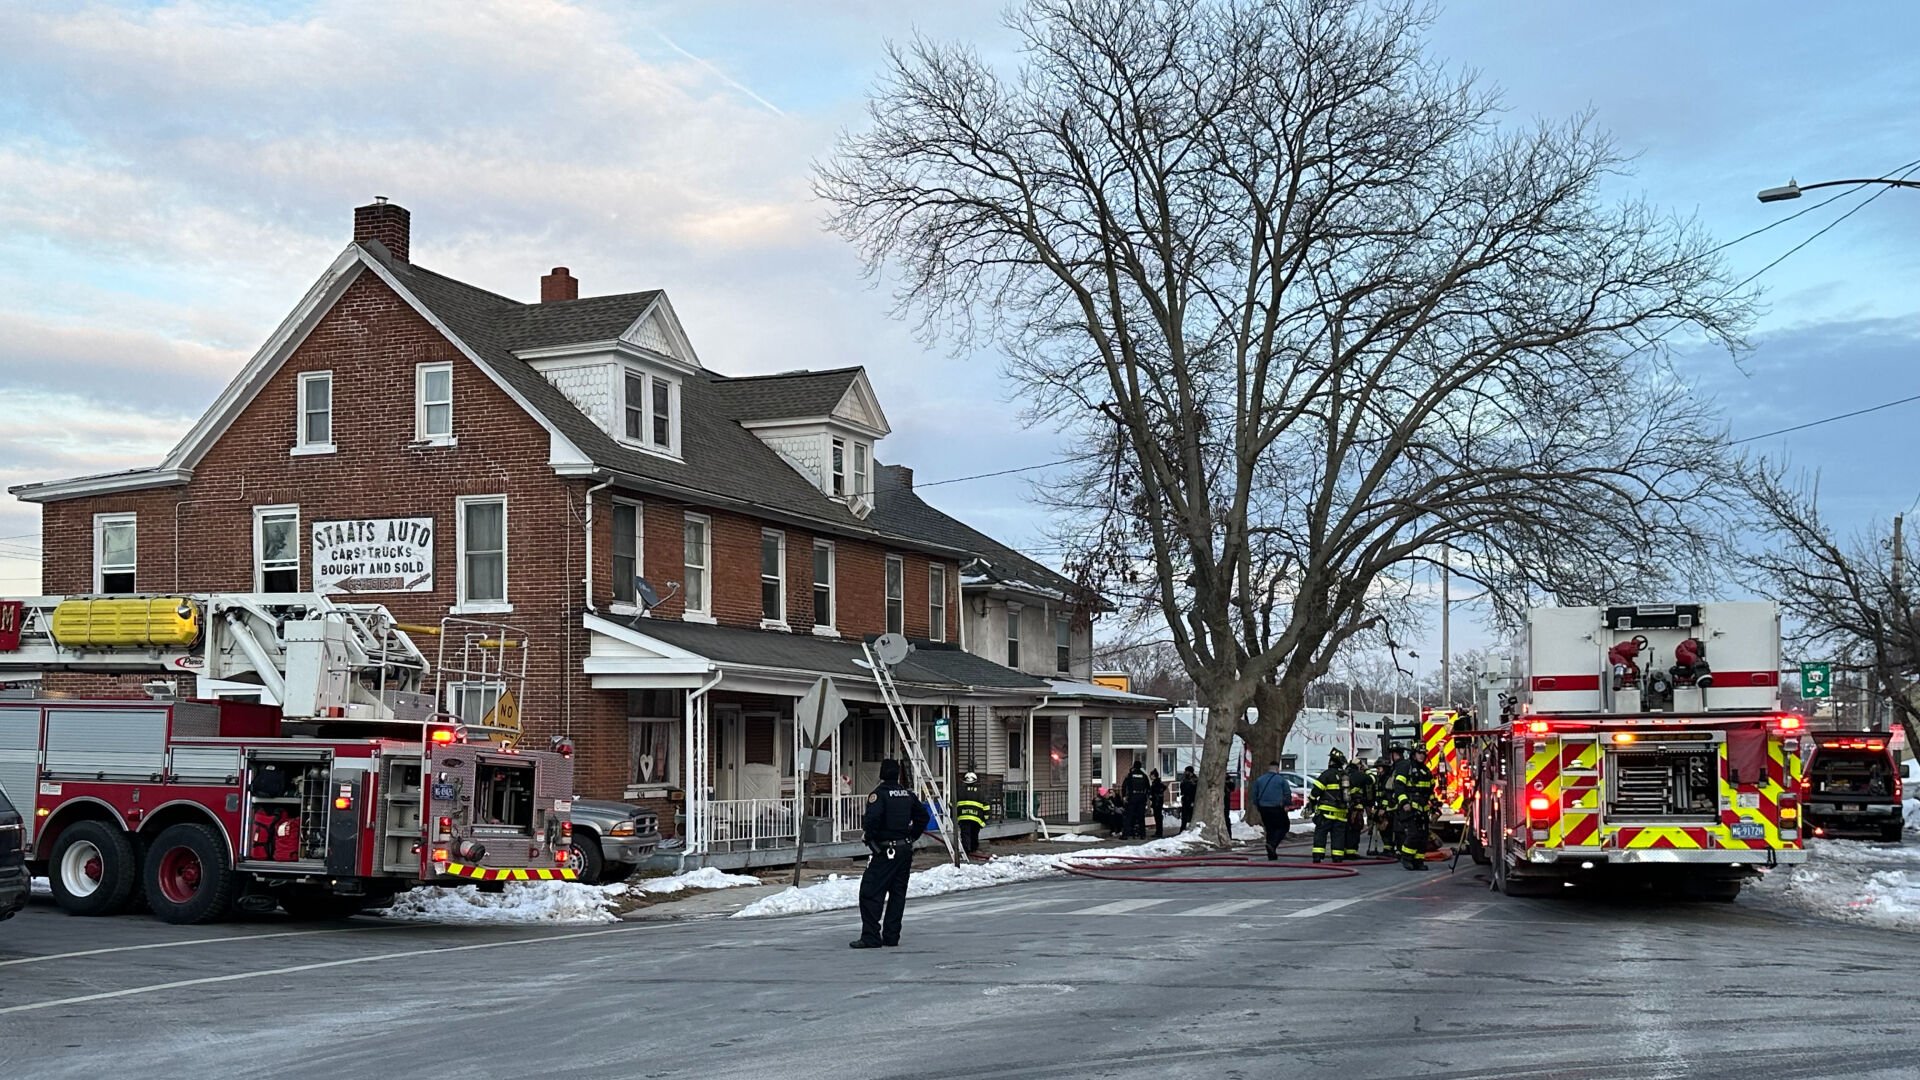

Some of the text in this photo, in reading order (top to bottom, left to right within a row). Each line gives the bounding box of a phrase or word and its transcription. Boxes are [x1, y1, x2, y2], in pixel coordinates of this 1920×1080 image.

[314, 520, 431, 551] STAATS AUTO
[331, 545, 412, 561] CARS TRUCKS
[321, 561, 424, 576] BOUGHT AND SOLD
[500, 704, 513, 719] NO
